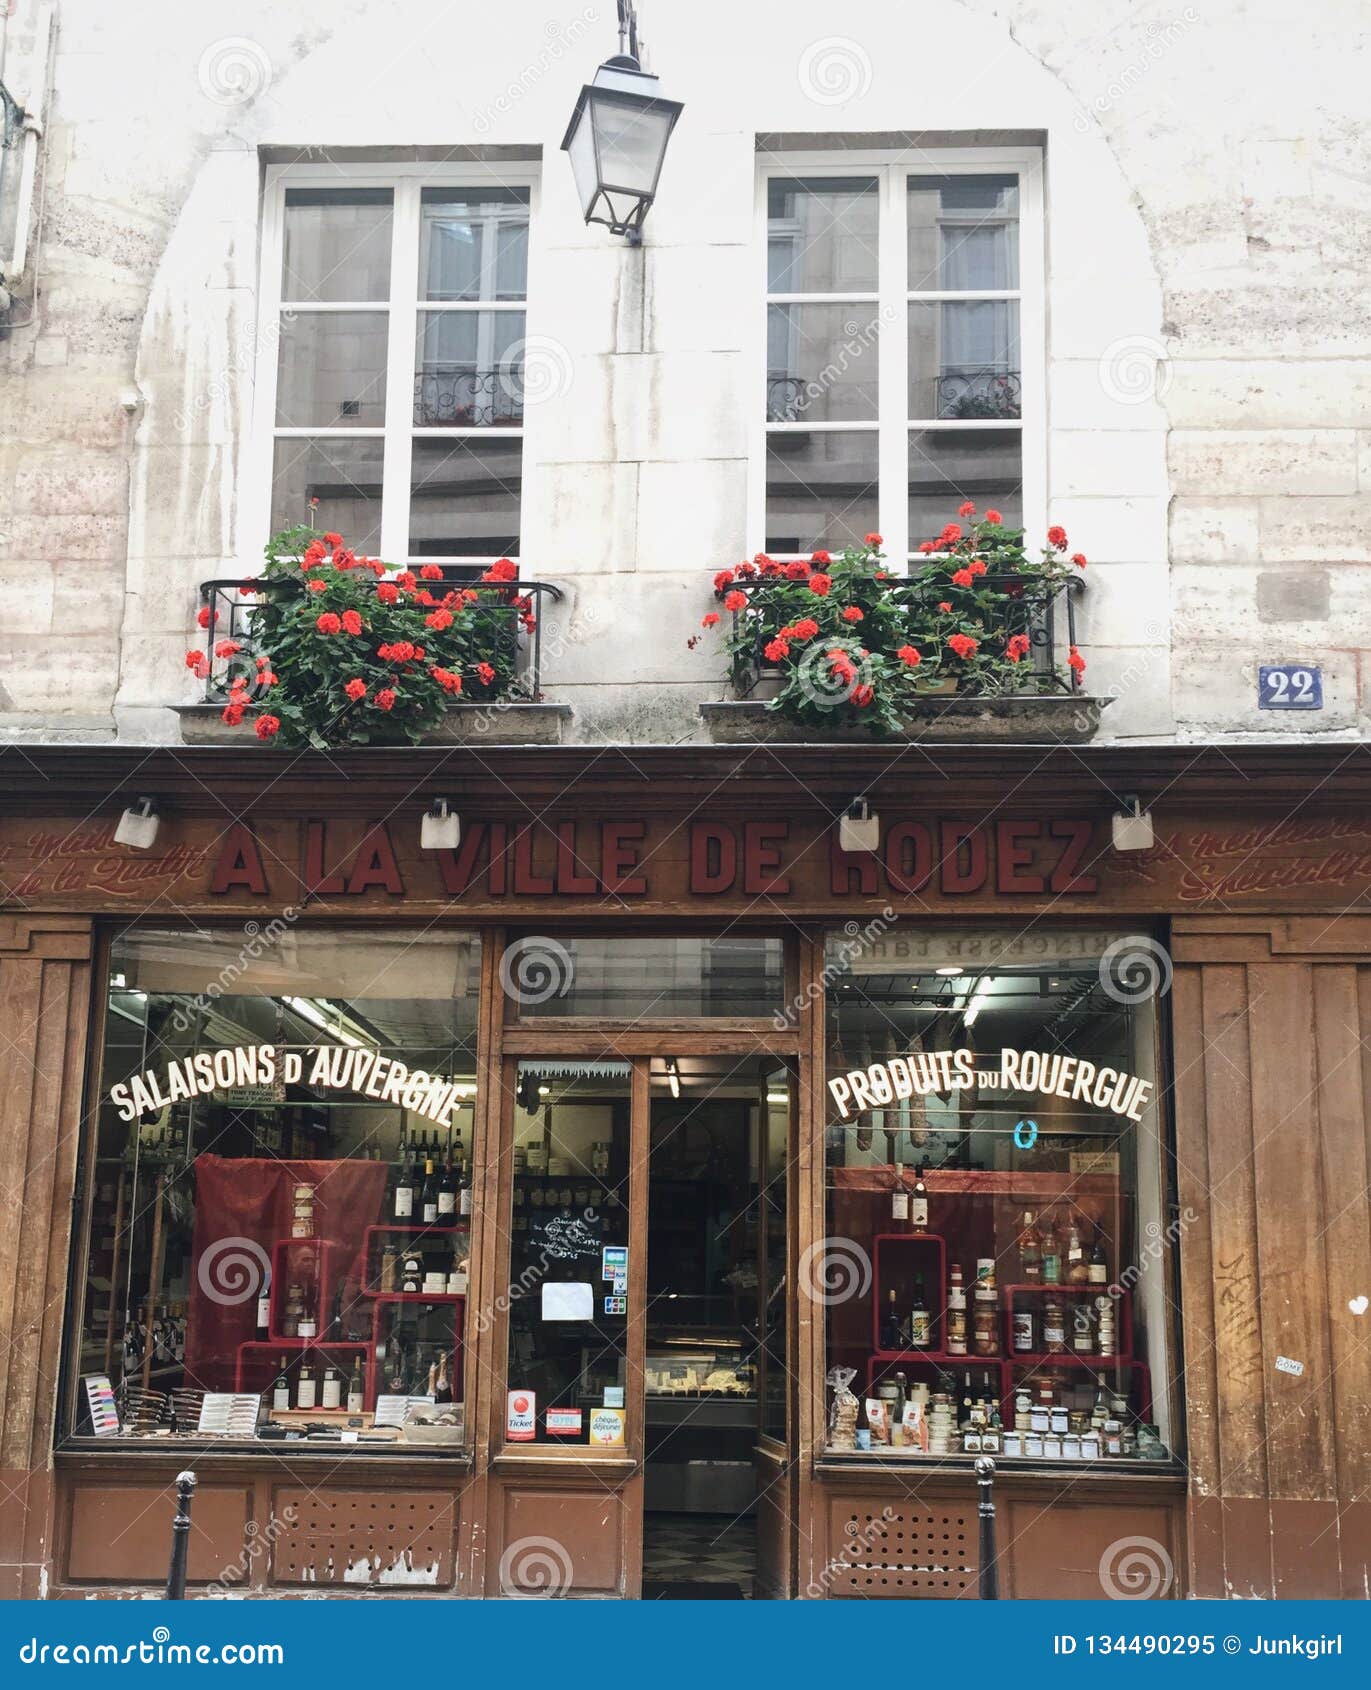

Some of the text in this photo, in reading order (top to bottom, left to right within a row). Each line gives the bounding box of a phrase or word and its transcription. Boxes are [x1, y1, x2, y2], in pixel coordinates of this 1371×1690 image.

[1267, 671, 1313, 703] 22
[211, 820, 1097, 896] A LA VILLE DE RODEZ
[111, 1044, 275, 1122] SALAISONS
[827, 1048, 1154, 1122] PRODUITS DU ROUERGUE
[509, 1419, 533, 1428] Ticket
